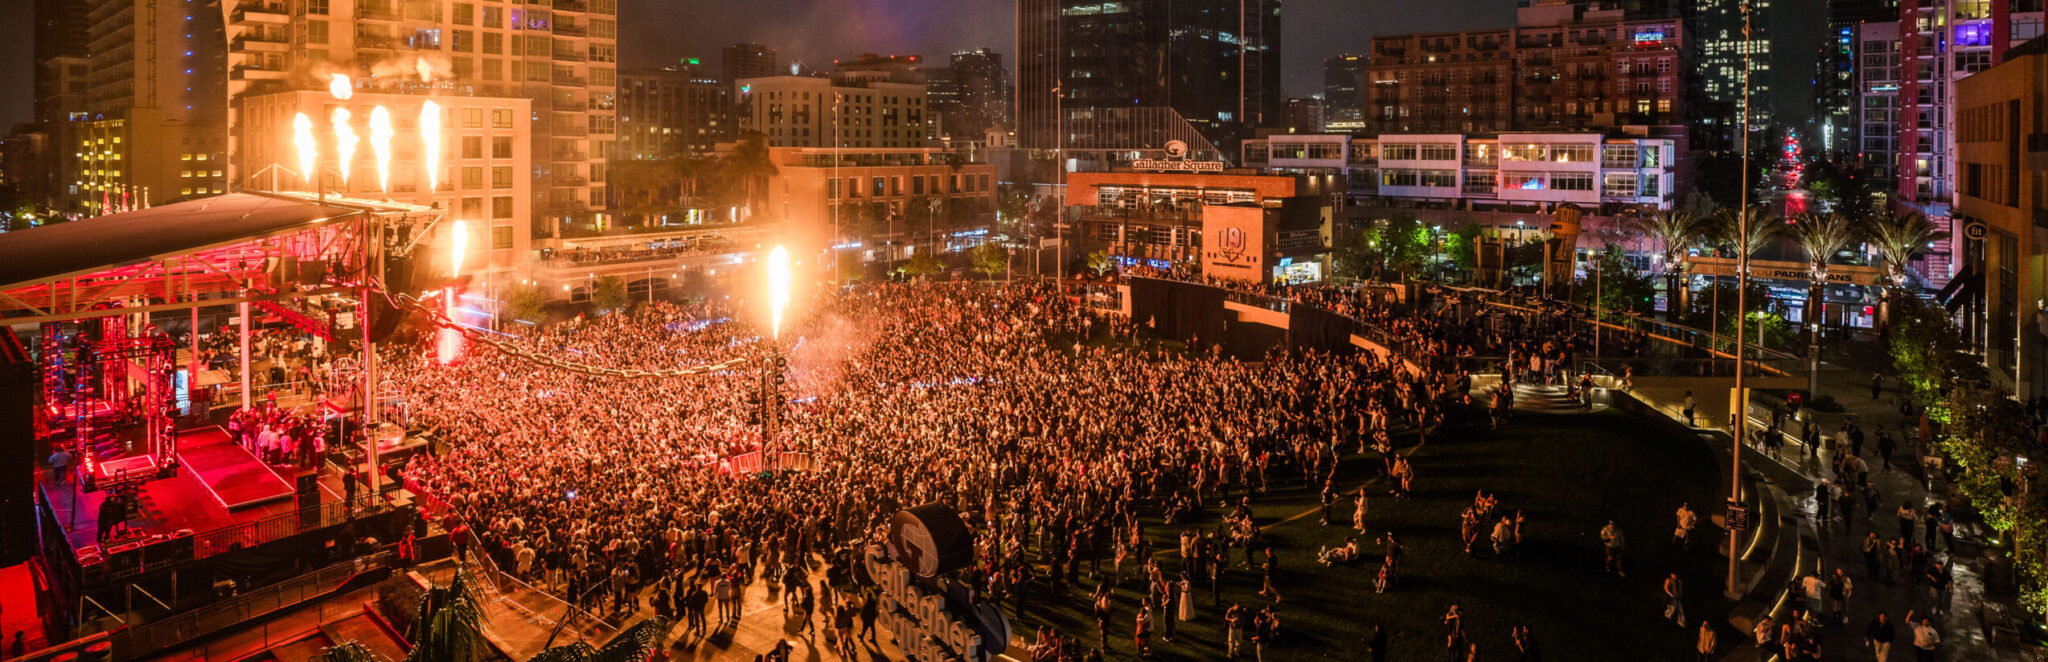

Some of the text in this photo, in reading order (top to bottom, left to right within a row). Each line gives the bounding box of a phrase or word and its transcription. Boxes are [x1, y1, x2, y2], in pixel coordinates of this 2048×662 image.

[1131, 159, 1223, 173] Gallagher Square
[1224, 226, 1241, 249] 19
[1825, 273, 1853, 282] ANS
[865, 544, 979, 662] Gallagher
[878, 591, 958, 662] Squa
